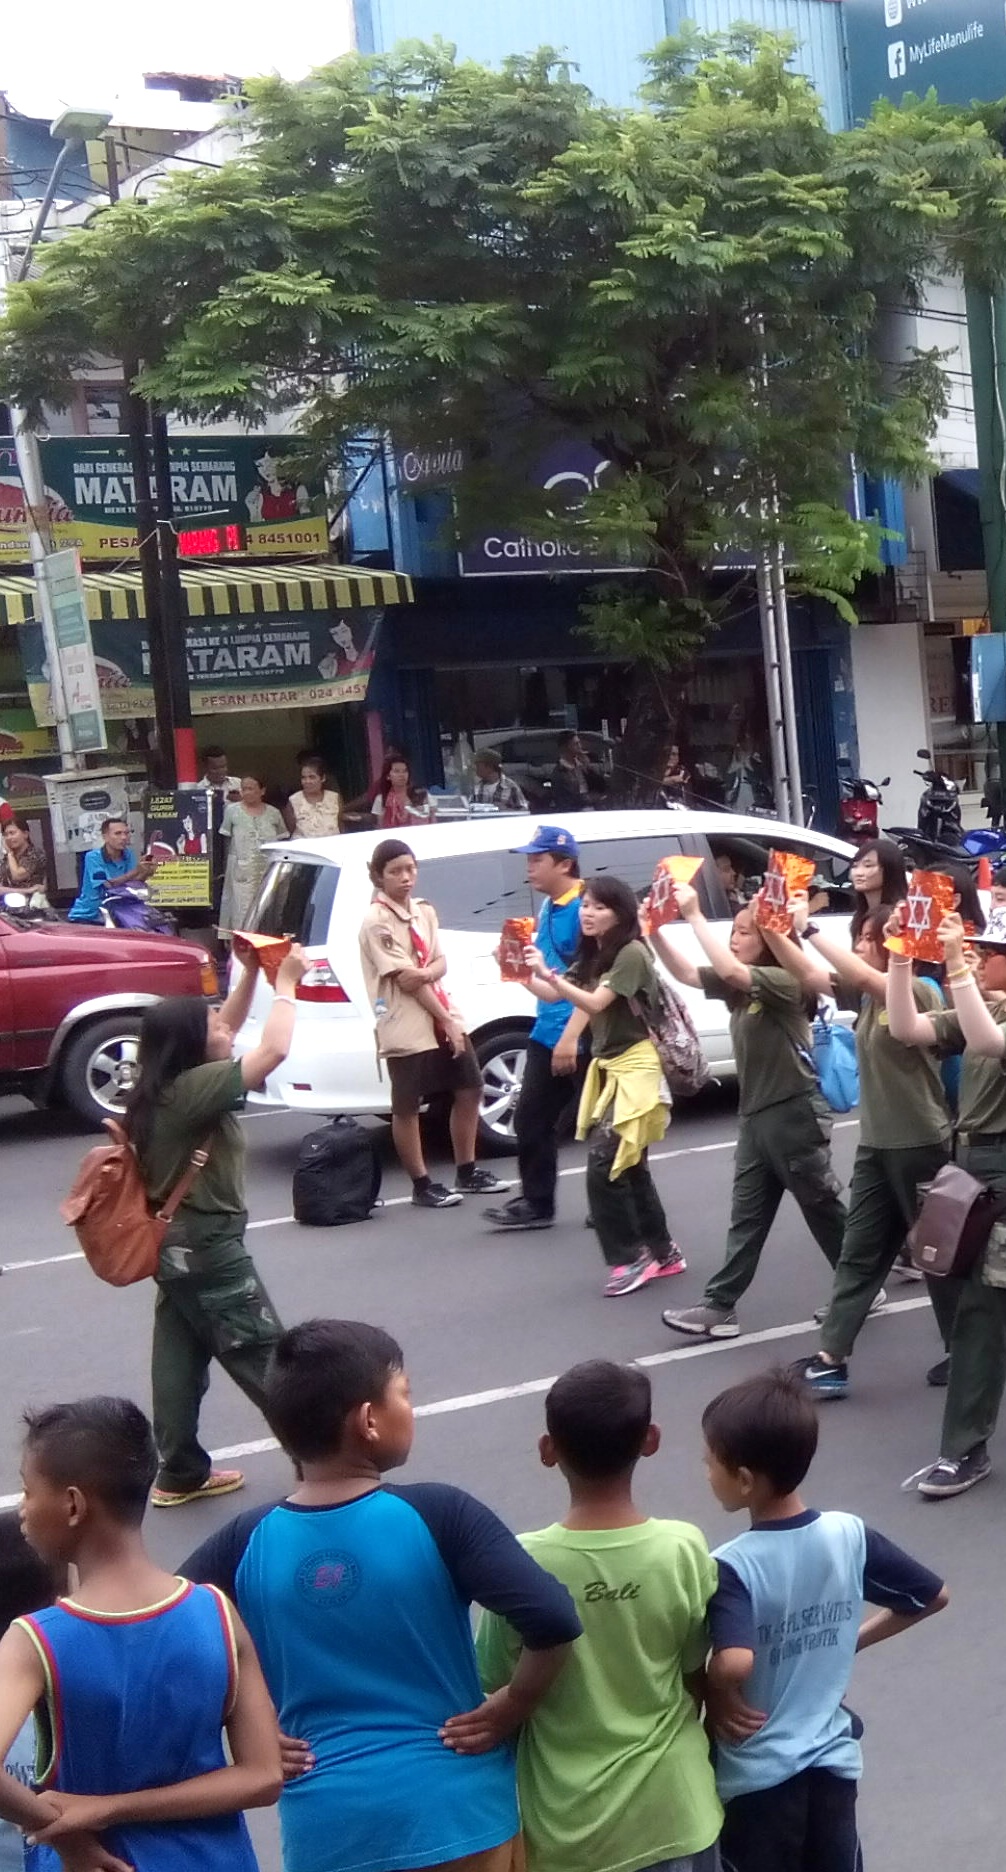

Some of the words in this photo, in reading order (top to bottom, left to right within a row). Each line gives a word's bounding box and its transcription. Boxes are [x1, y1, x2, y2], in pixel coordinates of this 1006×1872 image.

[909, 21, 985, 64] MyLifeManulife
[258, 532, 320, 544] 8451001
[201, 692, 247, 708] PESAN
[251, 689, 298, 704] ANTAR
[583, 1580, 641, 1602] Bali
